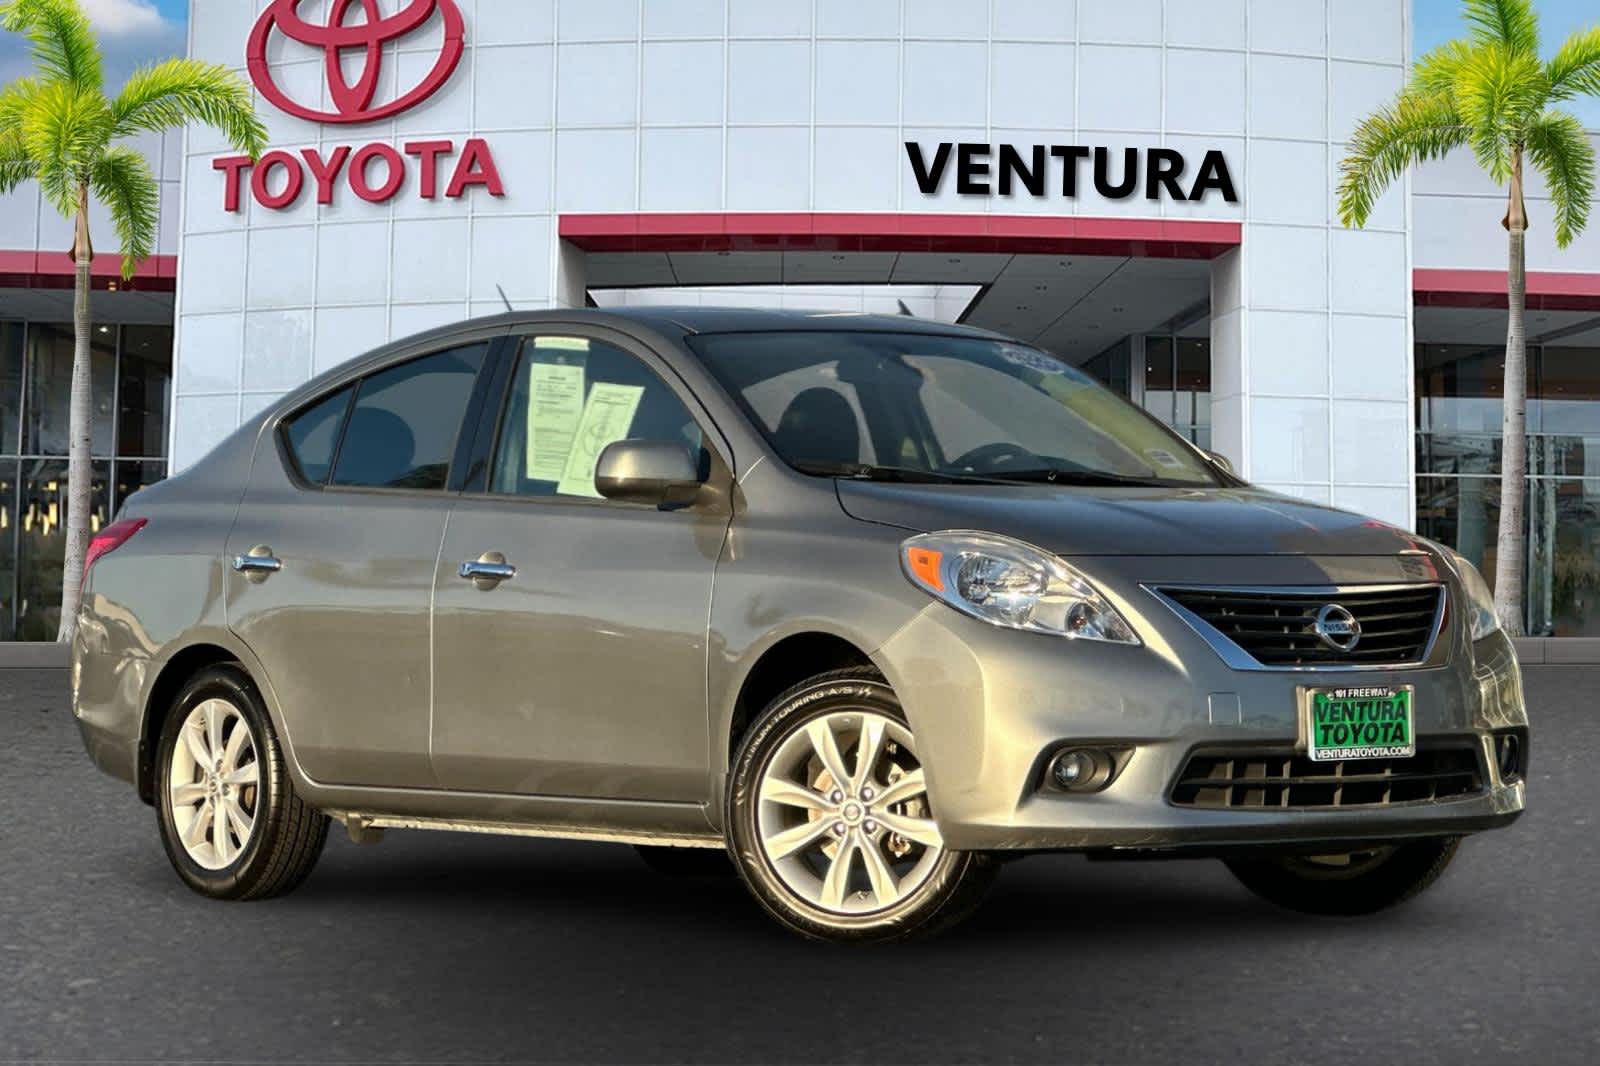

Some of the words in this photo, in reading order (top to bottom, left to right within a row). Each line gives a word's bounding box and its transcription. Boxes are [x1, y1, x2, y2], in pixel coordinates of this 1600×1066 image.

[212, 138, 505, 212] TOYOTA
[904, 141, 1238, 202] VENTURA
[1348, 688, 1388, 697] FREEWAY
[773, 691, 826, 723] TOURING
[1315, 701, 1407, 722] VENTURA
[1320, 722, 1405, 745] TOYOTA
[1316, 746, 1411, 759] VENTURATOYOTA.COM
